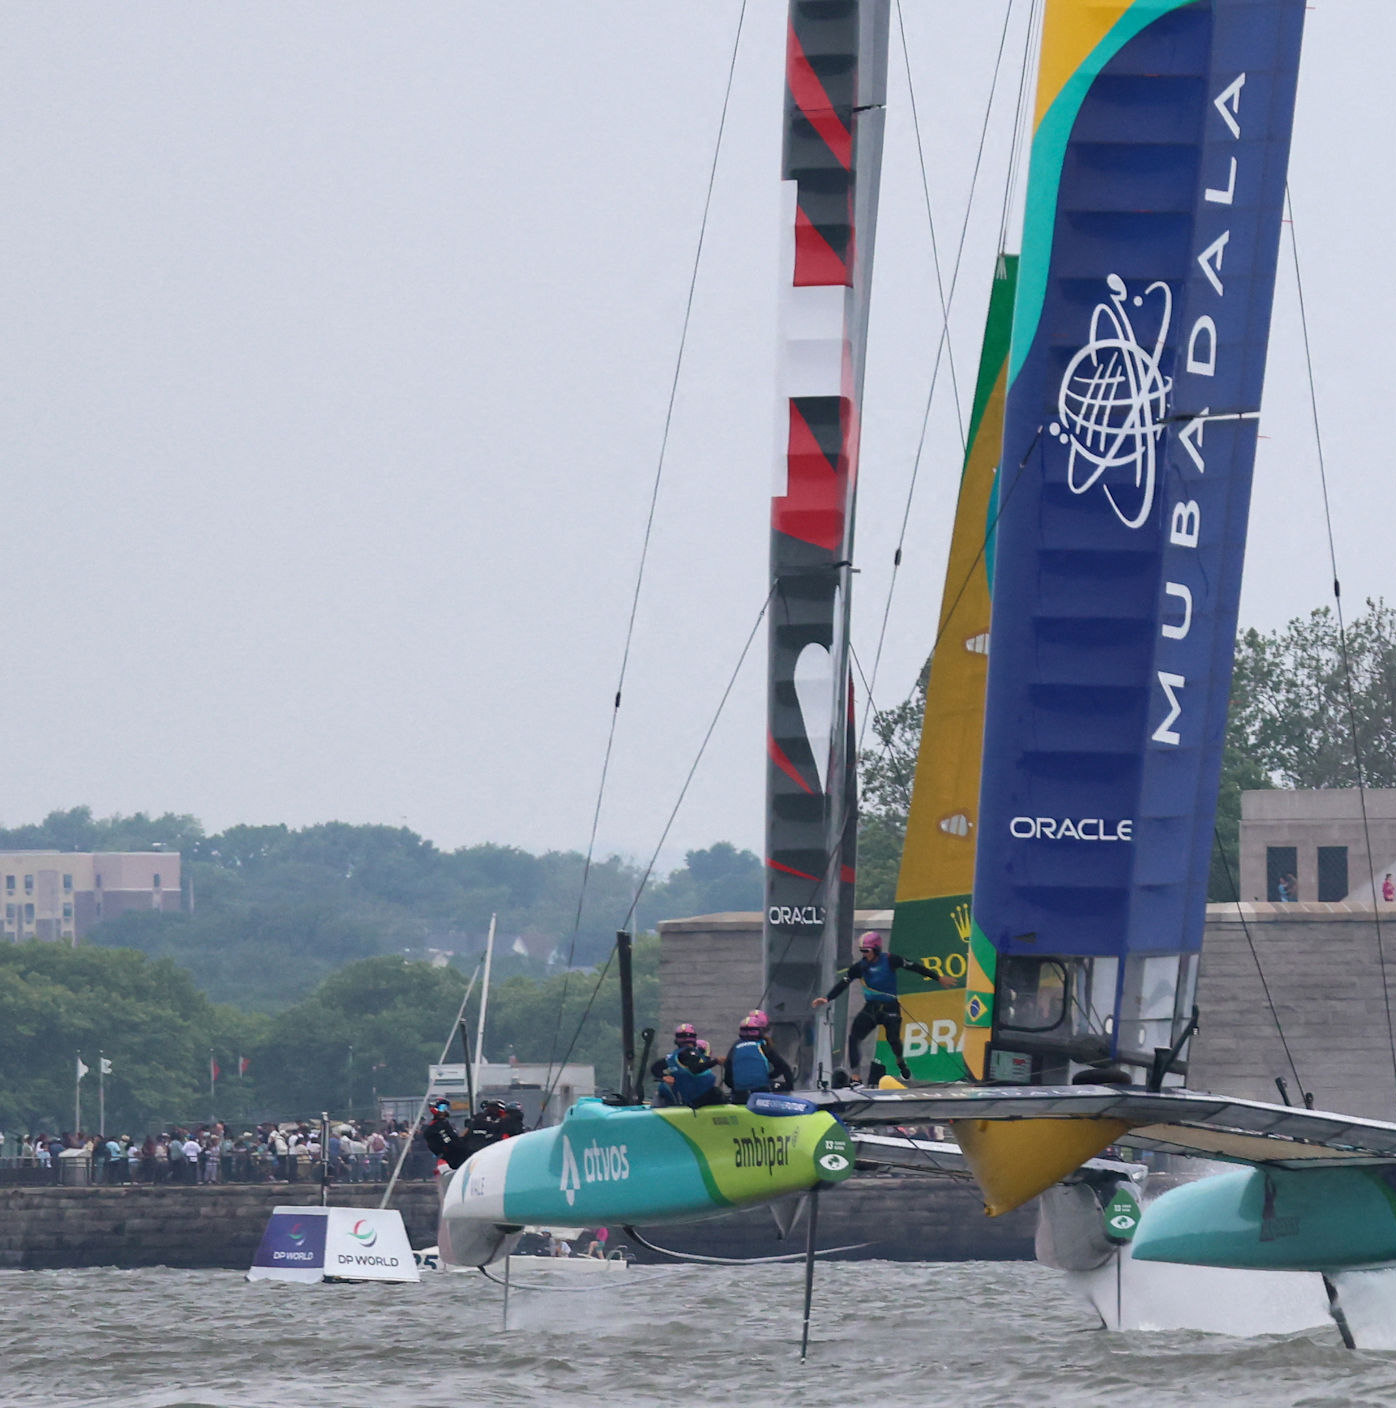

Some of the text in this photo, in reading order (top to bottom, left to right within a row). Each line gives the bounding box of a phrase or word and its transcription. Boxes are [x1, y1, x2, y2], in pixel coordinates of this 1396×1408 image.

[1152, 71, 1246, 745] MUBADALA
[1009, 816, 1134, 841] ORACLE
[768, 906, 826, 925] ORACL
[584, 1139, 630, 1183] atvos
[733, 1126, 791, 1176] ambipar
[273, 1251, 313, 1261] DP WORLD
[338, 1254, 399, 1267] DP WORLD
